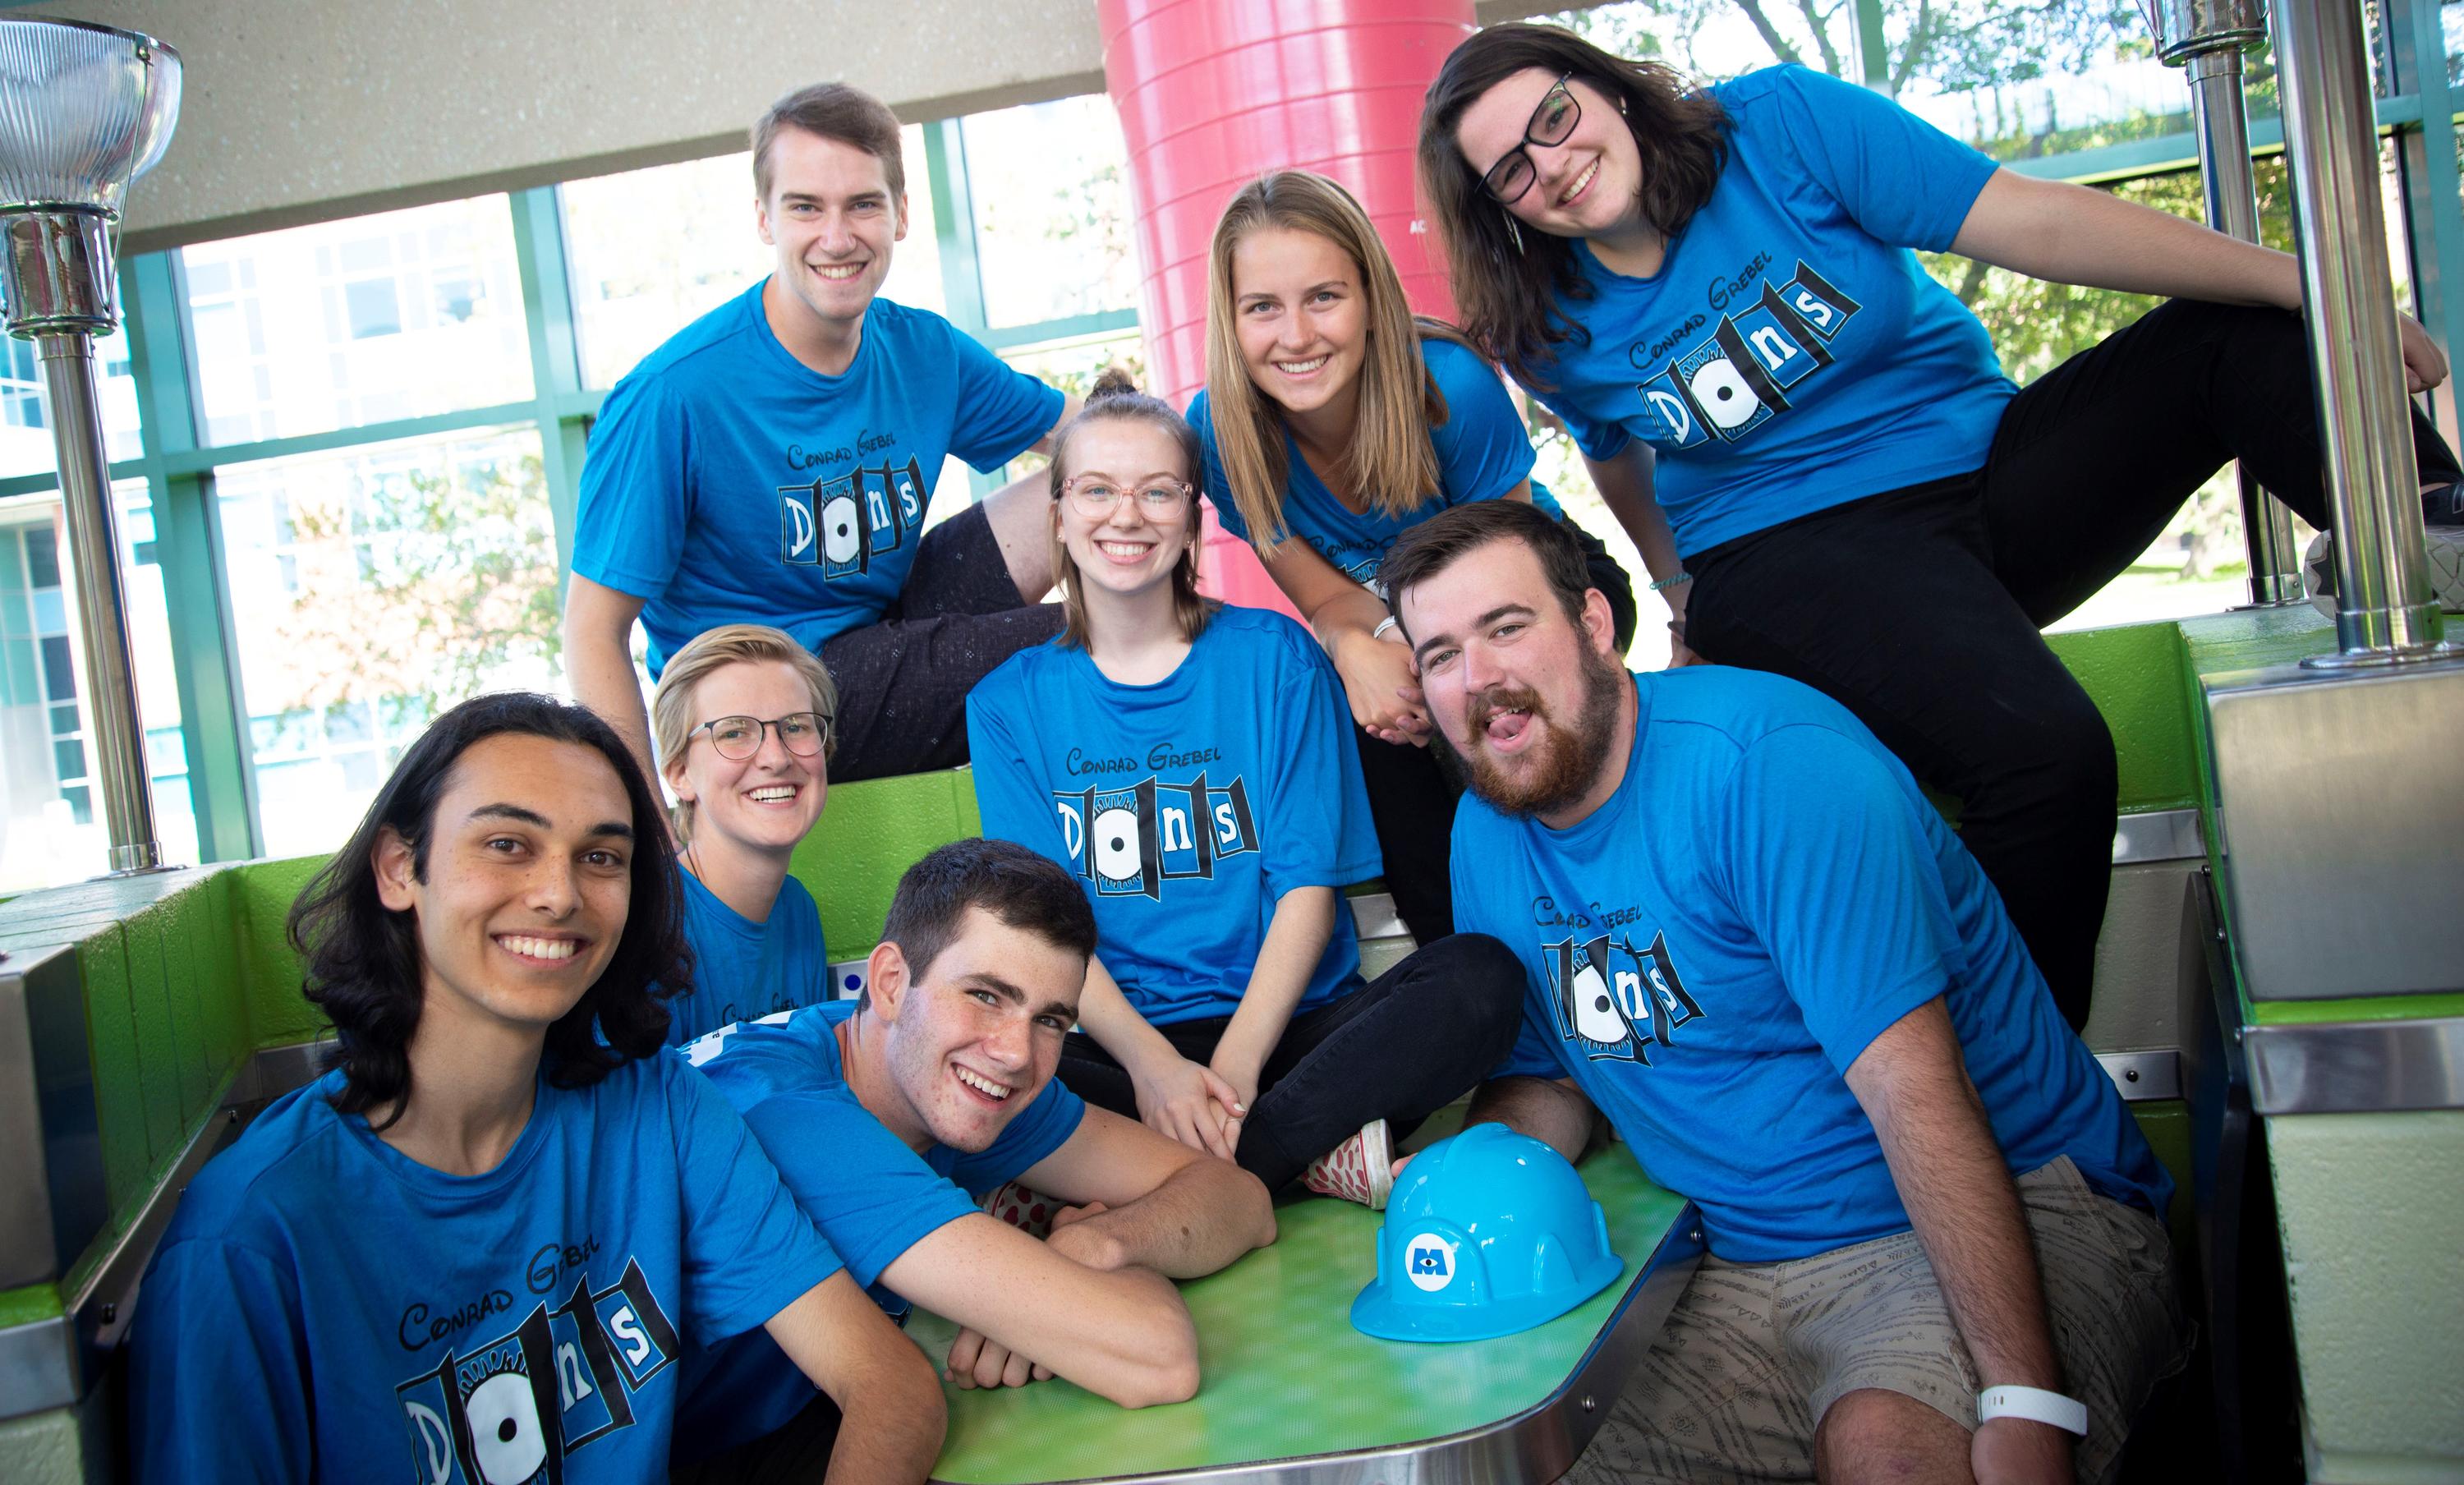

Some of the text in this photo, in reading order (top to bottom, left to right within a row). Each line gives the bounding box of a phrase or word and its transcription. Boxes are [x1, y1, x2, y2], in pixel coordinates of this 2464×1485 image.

[1630, 249, 1773, 370] CONRAD GREBEL
[787, 444, 852, 471] CONRAD
[1066, 742, 1222, 777] CONRAD GREBEL
[398, 1288, 514, 1353] CONRAD
